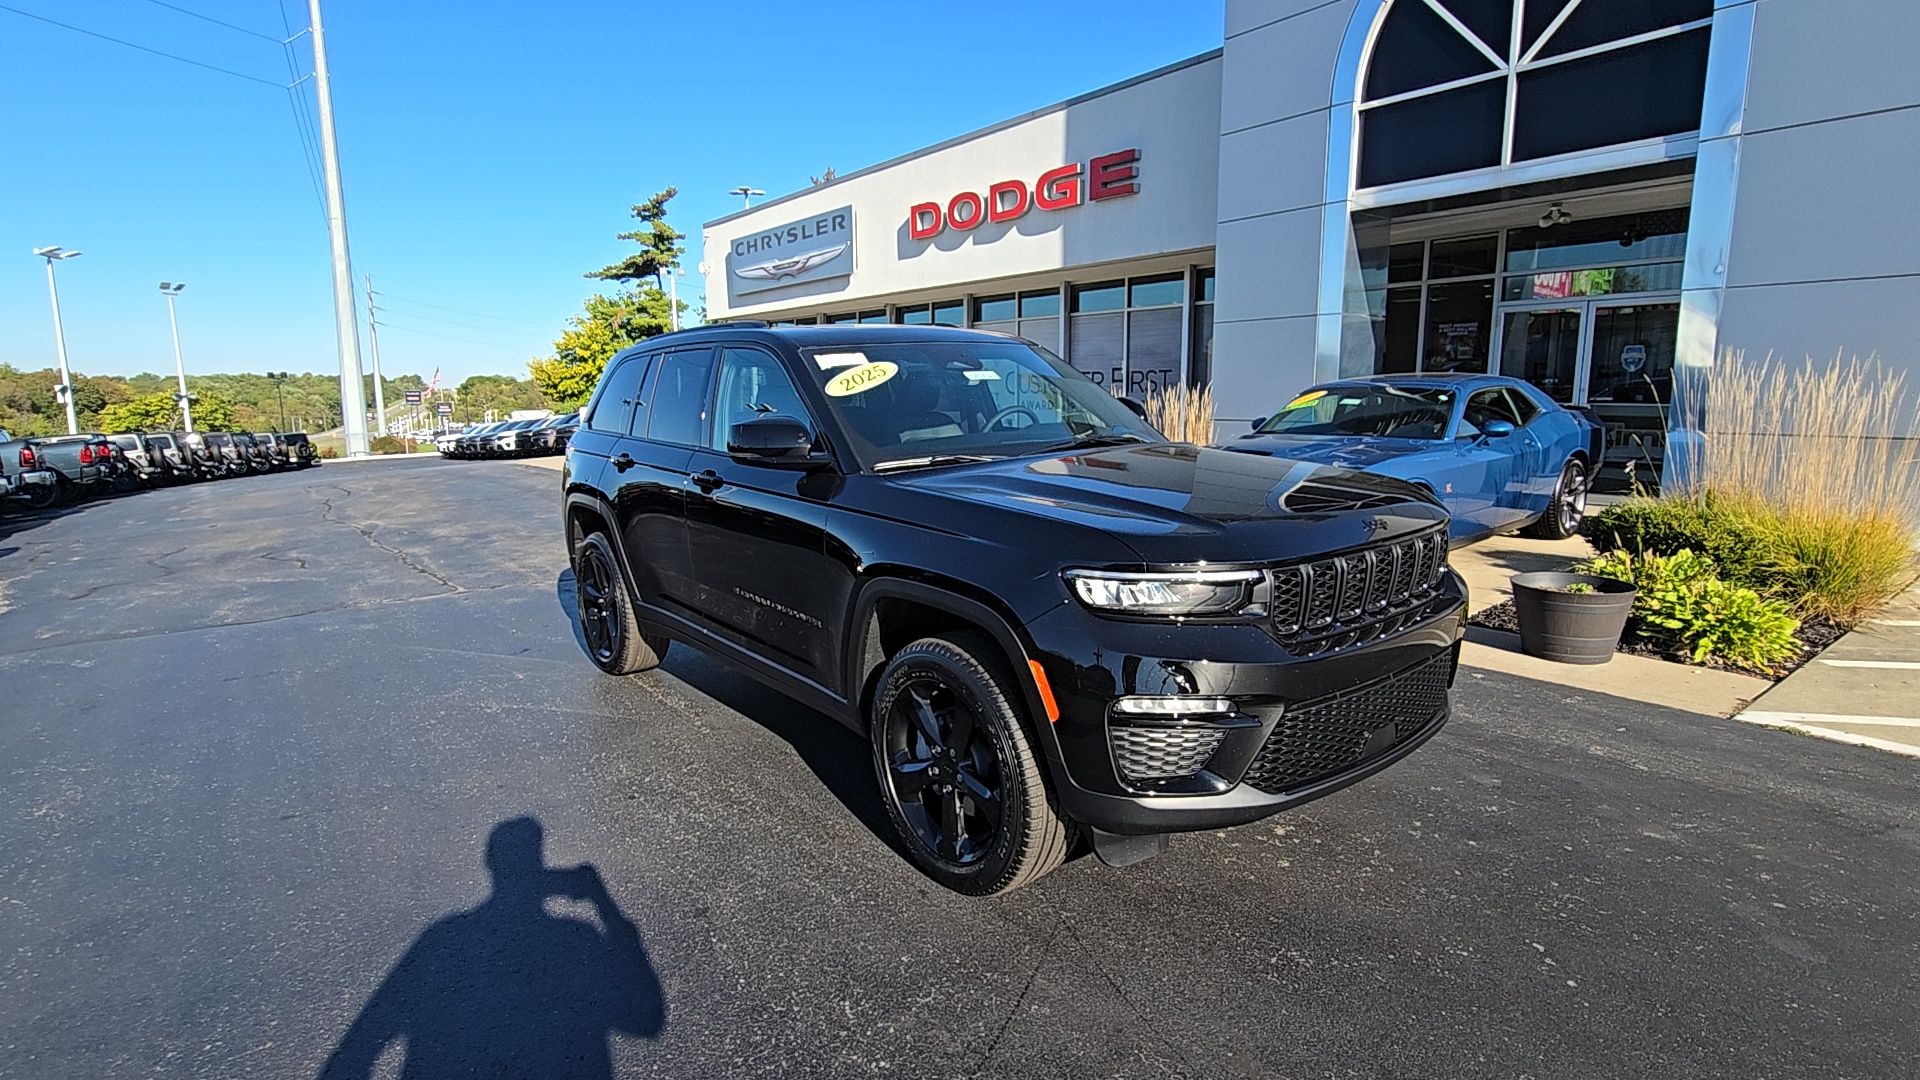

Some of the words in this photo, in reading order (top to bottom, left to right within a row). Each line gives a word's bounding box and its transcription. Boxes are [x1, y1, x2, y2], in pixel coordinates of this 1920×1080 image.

[909, 148, 1140, 240] DODGE
[735, 214, 846, 257] CHRYSLER
[840, 365, 887, 391] 2025
